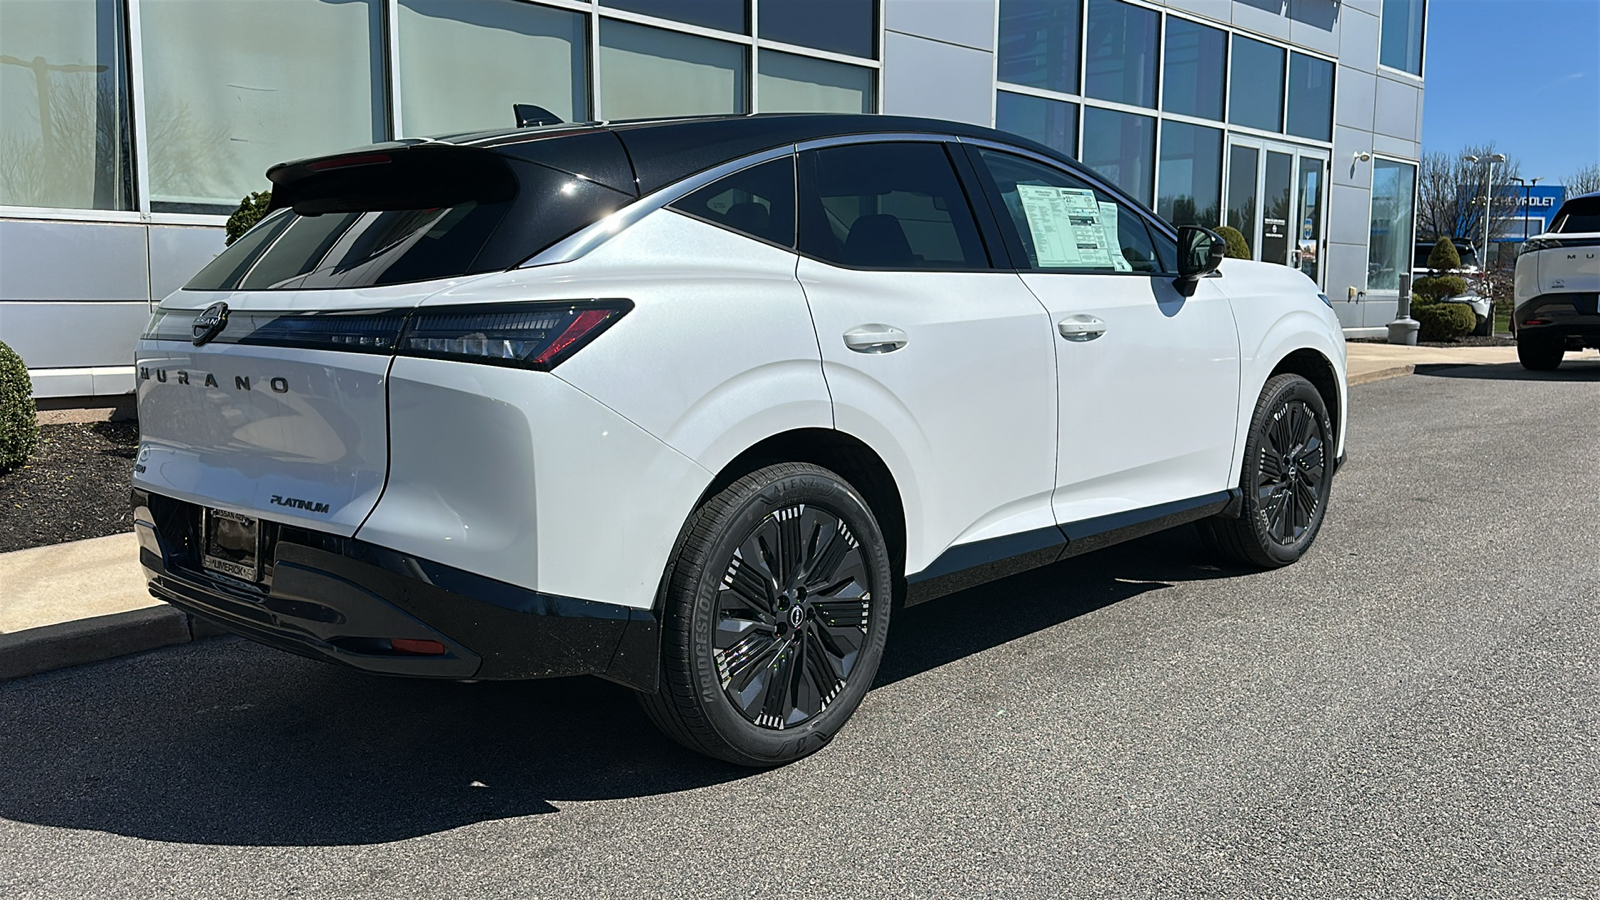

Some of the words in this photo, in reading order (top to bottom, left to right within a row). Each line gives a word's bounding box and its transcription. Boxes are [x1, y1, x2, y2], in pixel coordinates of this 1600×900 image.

[140, 366, 289, 393] MURANO
[270, 495, 330, 514] PLATINUM
[214, 558, 243, 576] LIMERICK
[695, 572, 717, 703] BRIDGESTONE
